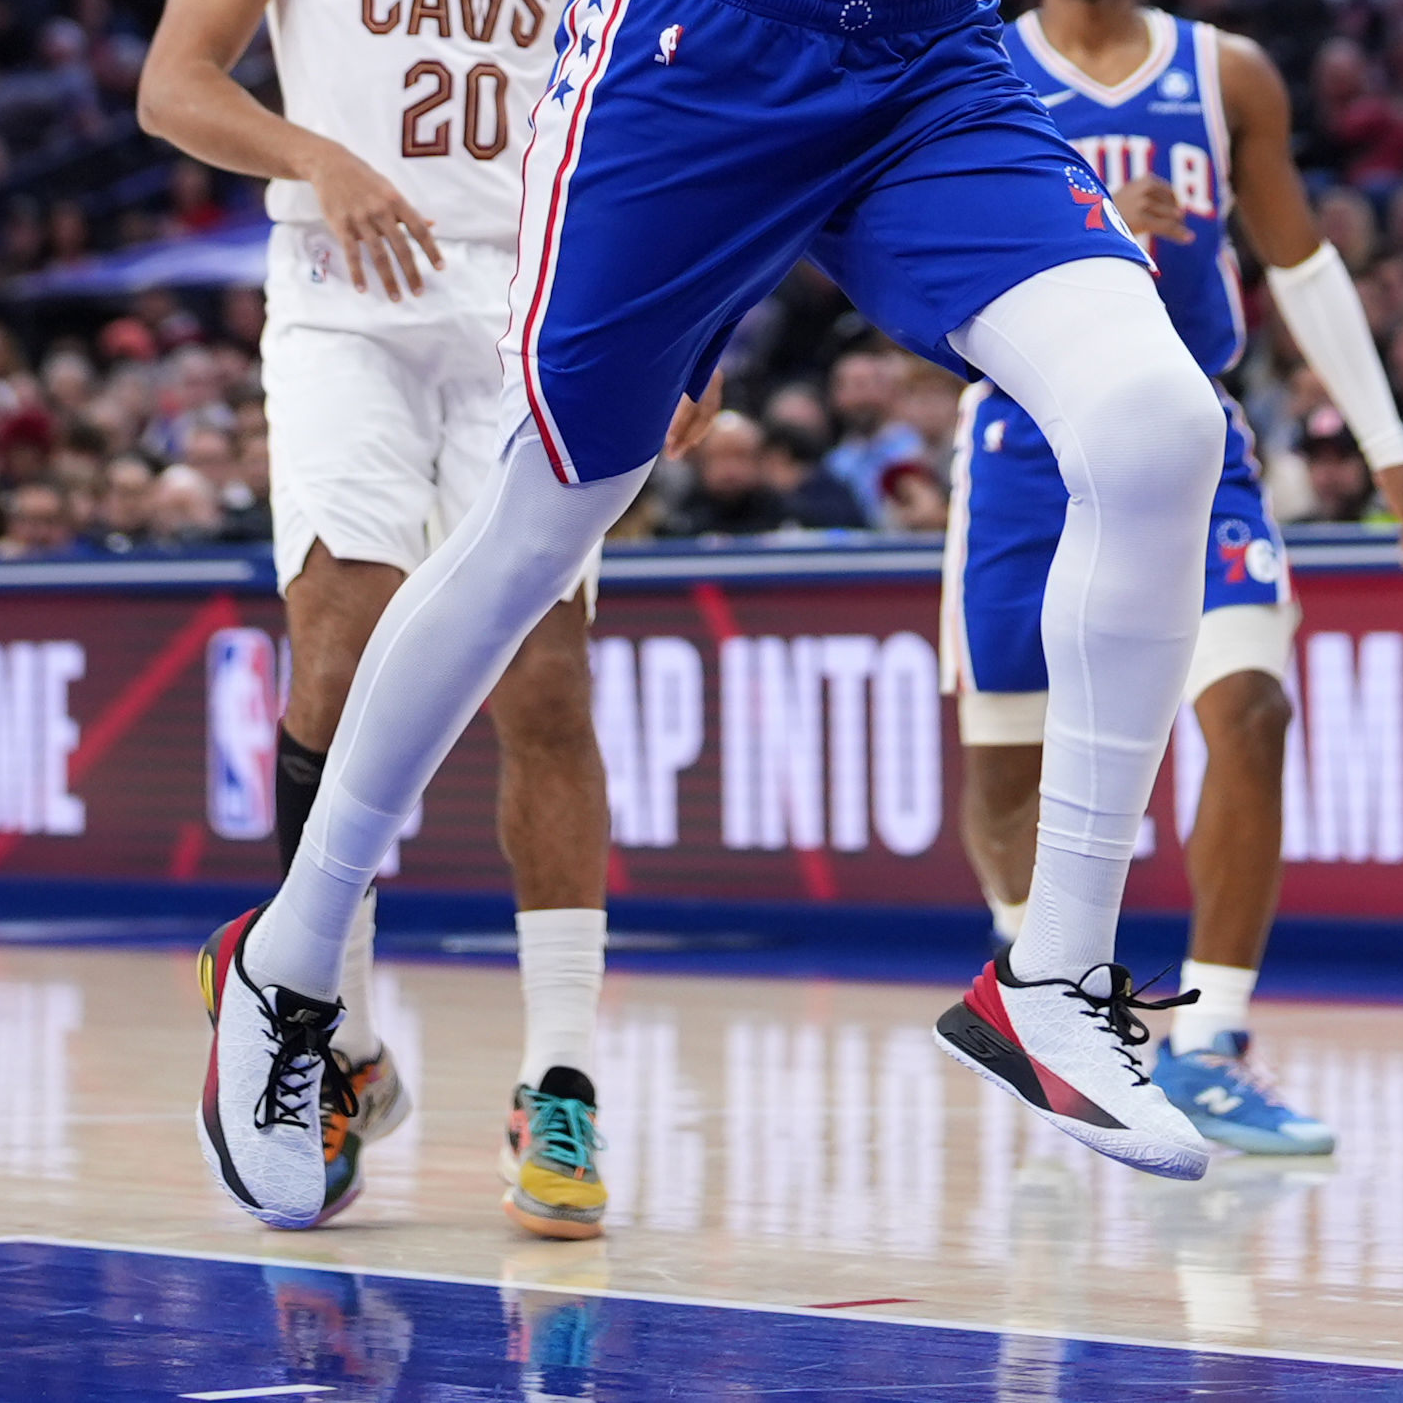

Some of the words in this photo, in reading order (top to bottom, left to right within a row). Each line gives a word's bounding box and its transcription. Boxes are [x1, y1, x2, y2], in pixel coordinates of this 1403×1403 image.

[401, 60, 509, 161] 20
[585, 634, 705, 848] AP
[719, 630, 944, 855] INTO
